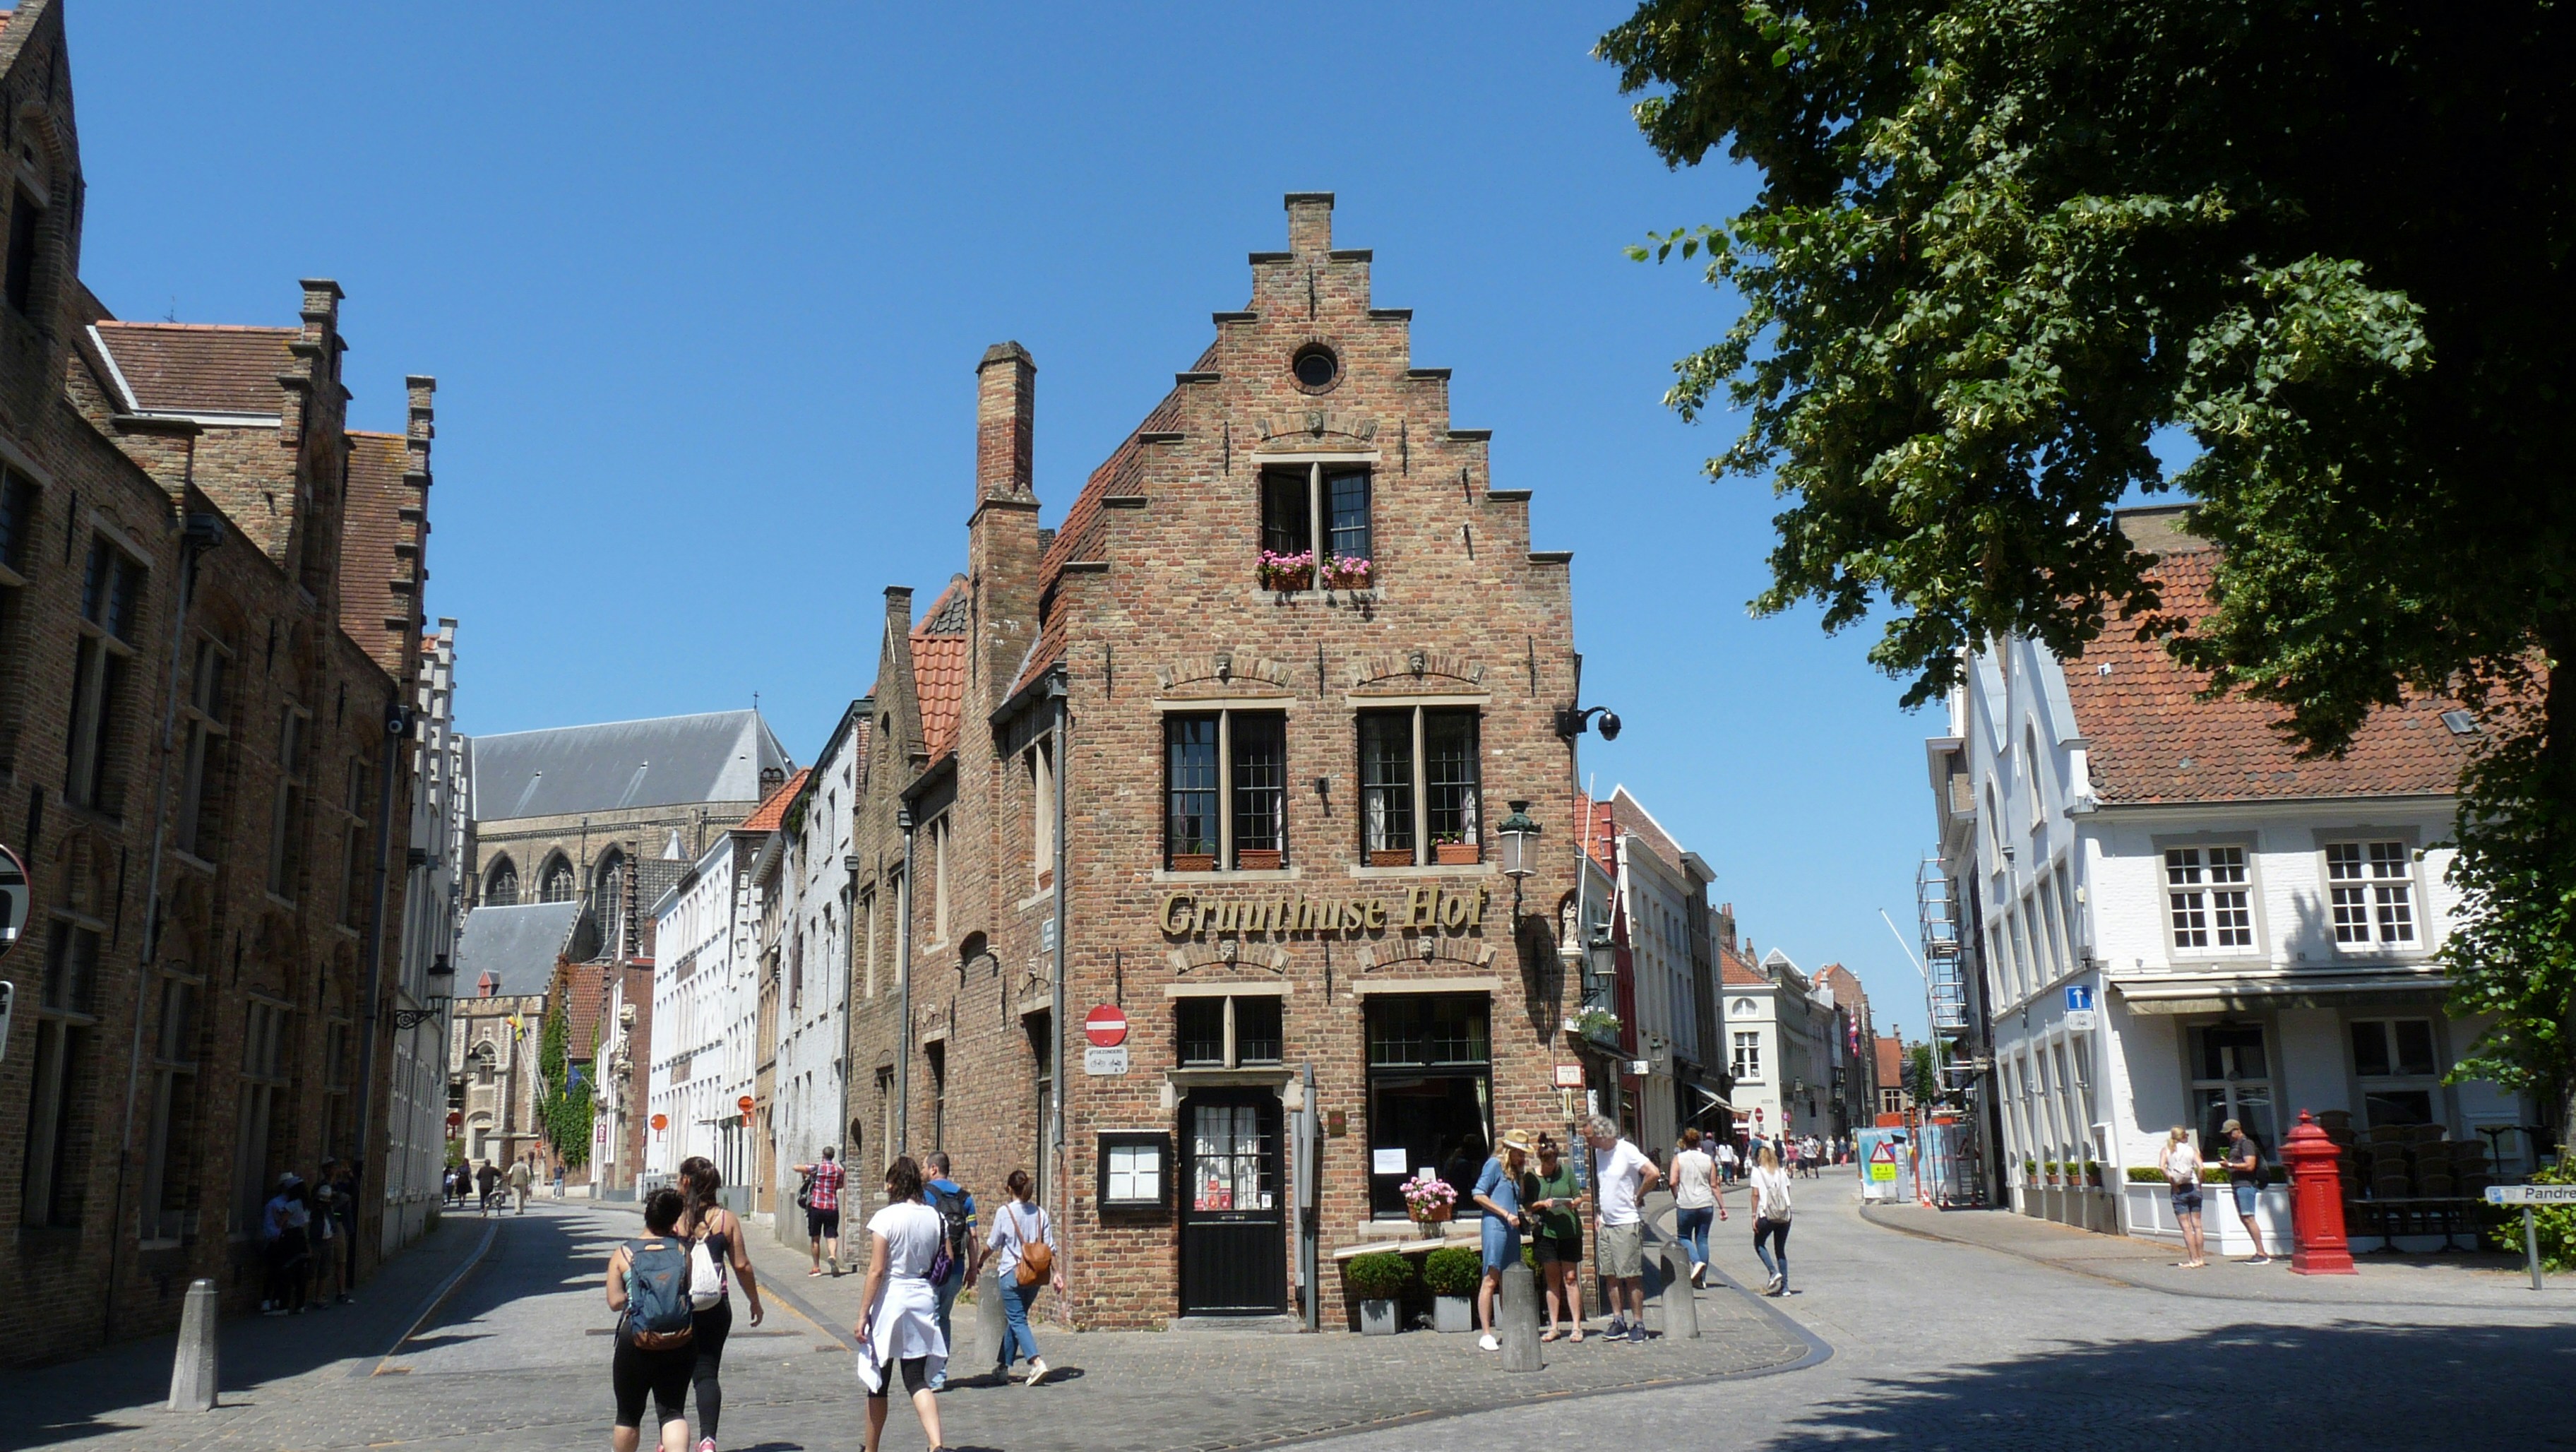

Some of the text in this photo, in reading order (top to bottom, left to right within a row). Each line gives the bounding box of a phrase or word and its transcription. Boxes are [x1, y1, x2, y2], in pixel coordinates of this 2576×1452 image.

[1158, 883, 1489, 935] Gruuthuse Hof
[2525, 1187, 2576, 1199] Pandre
